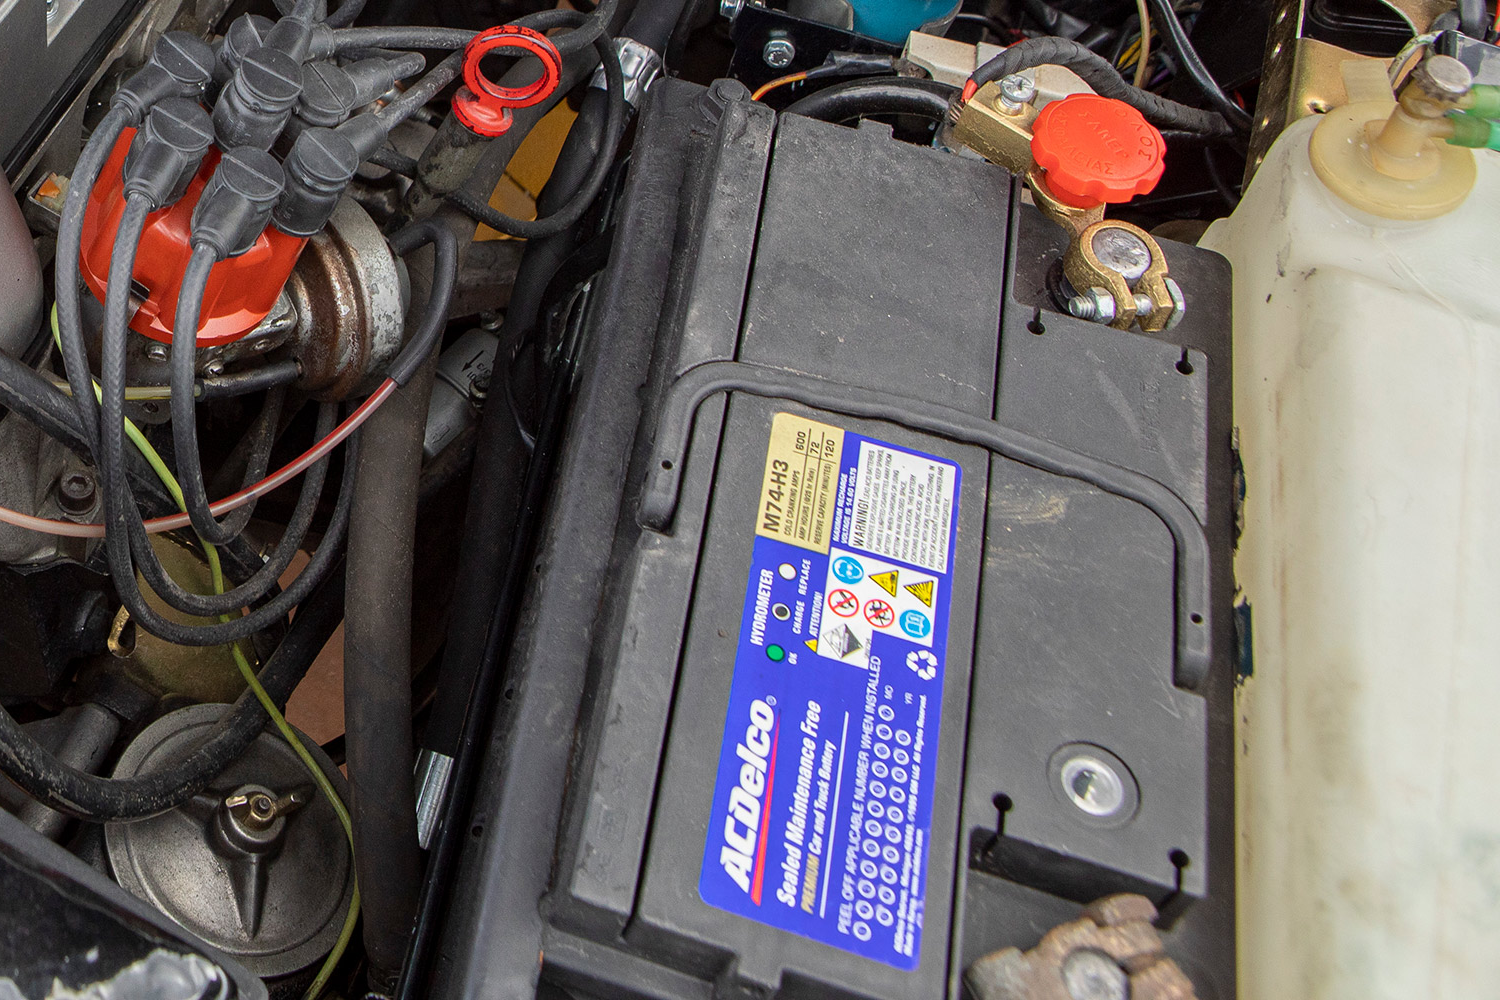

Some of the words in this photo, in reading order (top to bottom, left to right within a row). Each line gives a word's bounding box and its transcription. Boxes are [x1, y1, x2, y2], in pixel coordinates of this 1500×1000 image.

[795, 430, 806, 450] 600
[809, 441, 819, 454] 72
[824, 438, 835, 457] 120
[762, 459, 789, 532] M74-H3
[836, 472, 848, 507] RECHARGE
[840, 515, 850, 544] VOLTAGE
[848, 467, 857, 487] VOLTS
[832, 506, 843, 542] MAXIMUM
[852, 498, 869, 546] WARNING!
[797, 558, 811, 595] REPLACE
[749, 568, 773, 645] HYDROMETER
[792, 600, 805, 634] CHARGE
[808, 590, 823, 637] ATTENTION!
[787, 651, 797, 664] OK
[864, 655, 881, 714] INSTALLED
[799, 699, 821, 738] Free
[860, 713, 874, 749] WHEN
[817, 739, 837, 781] Battery
[853, 750, 869, 801] NUMBER
[720, 699, 774, 892] ACDelco
[784, 736, 816, 845] Maintenance
[813, 779, 829, 811] Truck
[812, 809, 826, 835] and
[844, 801, 864, 875] APPLICABLE
[807, 832, 822, 855] Car
[776, 841, 801, 907] Sealed
[800, 852, 819, 913] PREMIUM
[841, 873, 855, 901] OFF
[837, 902, 853, 934] PEEL
